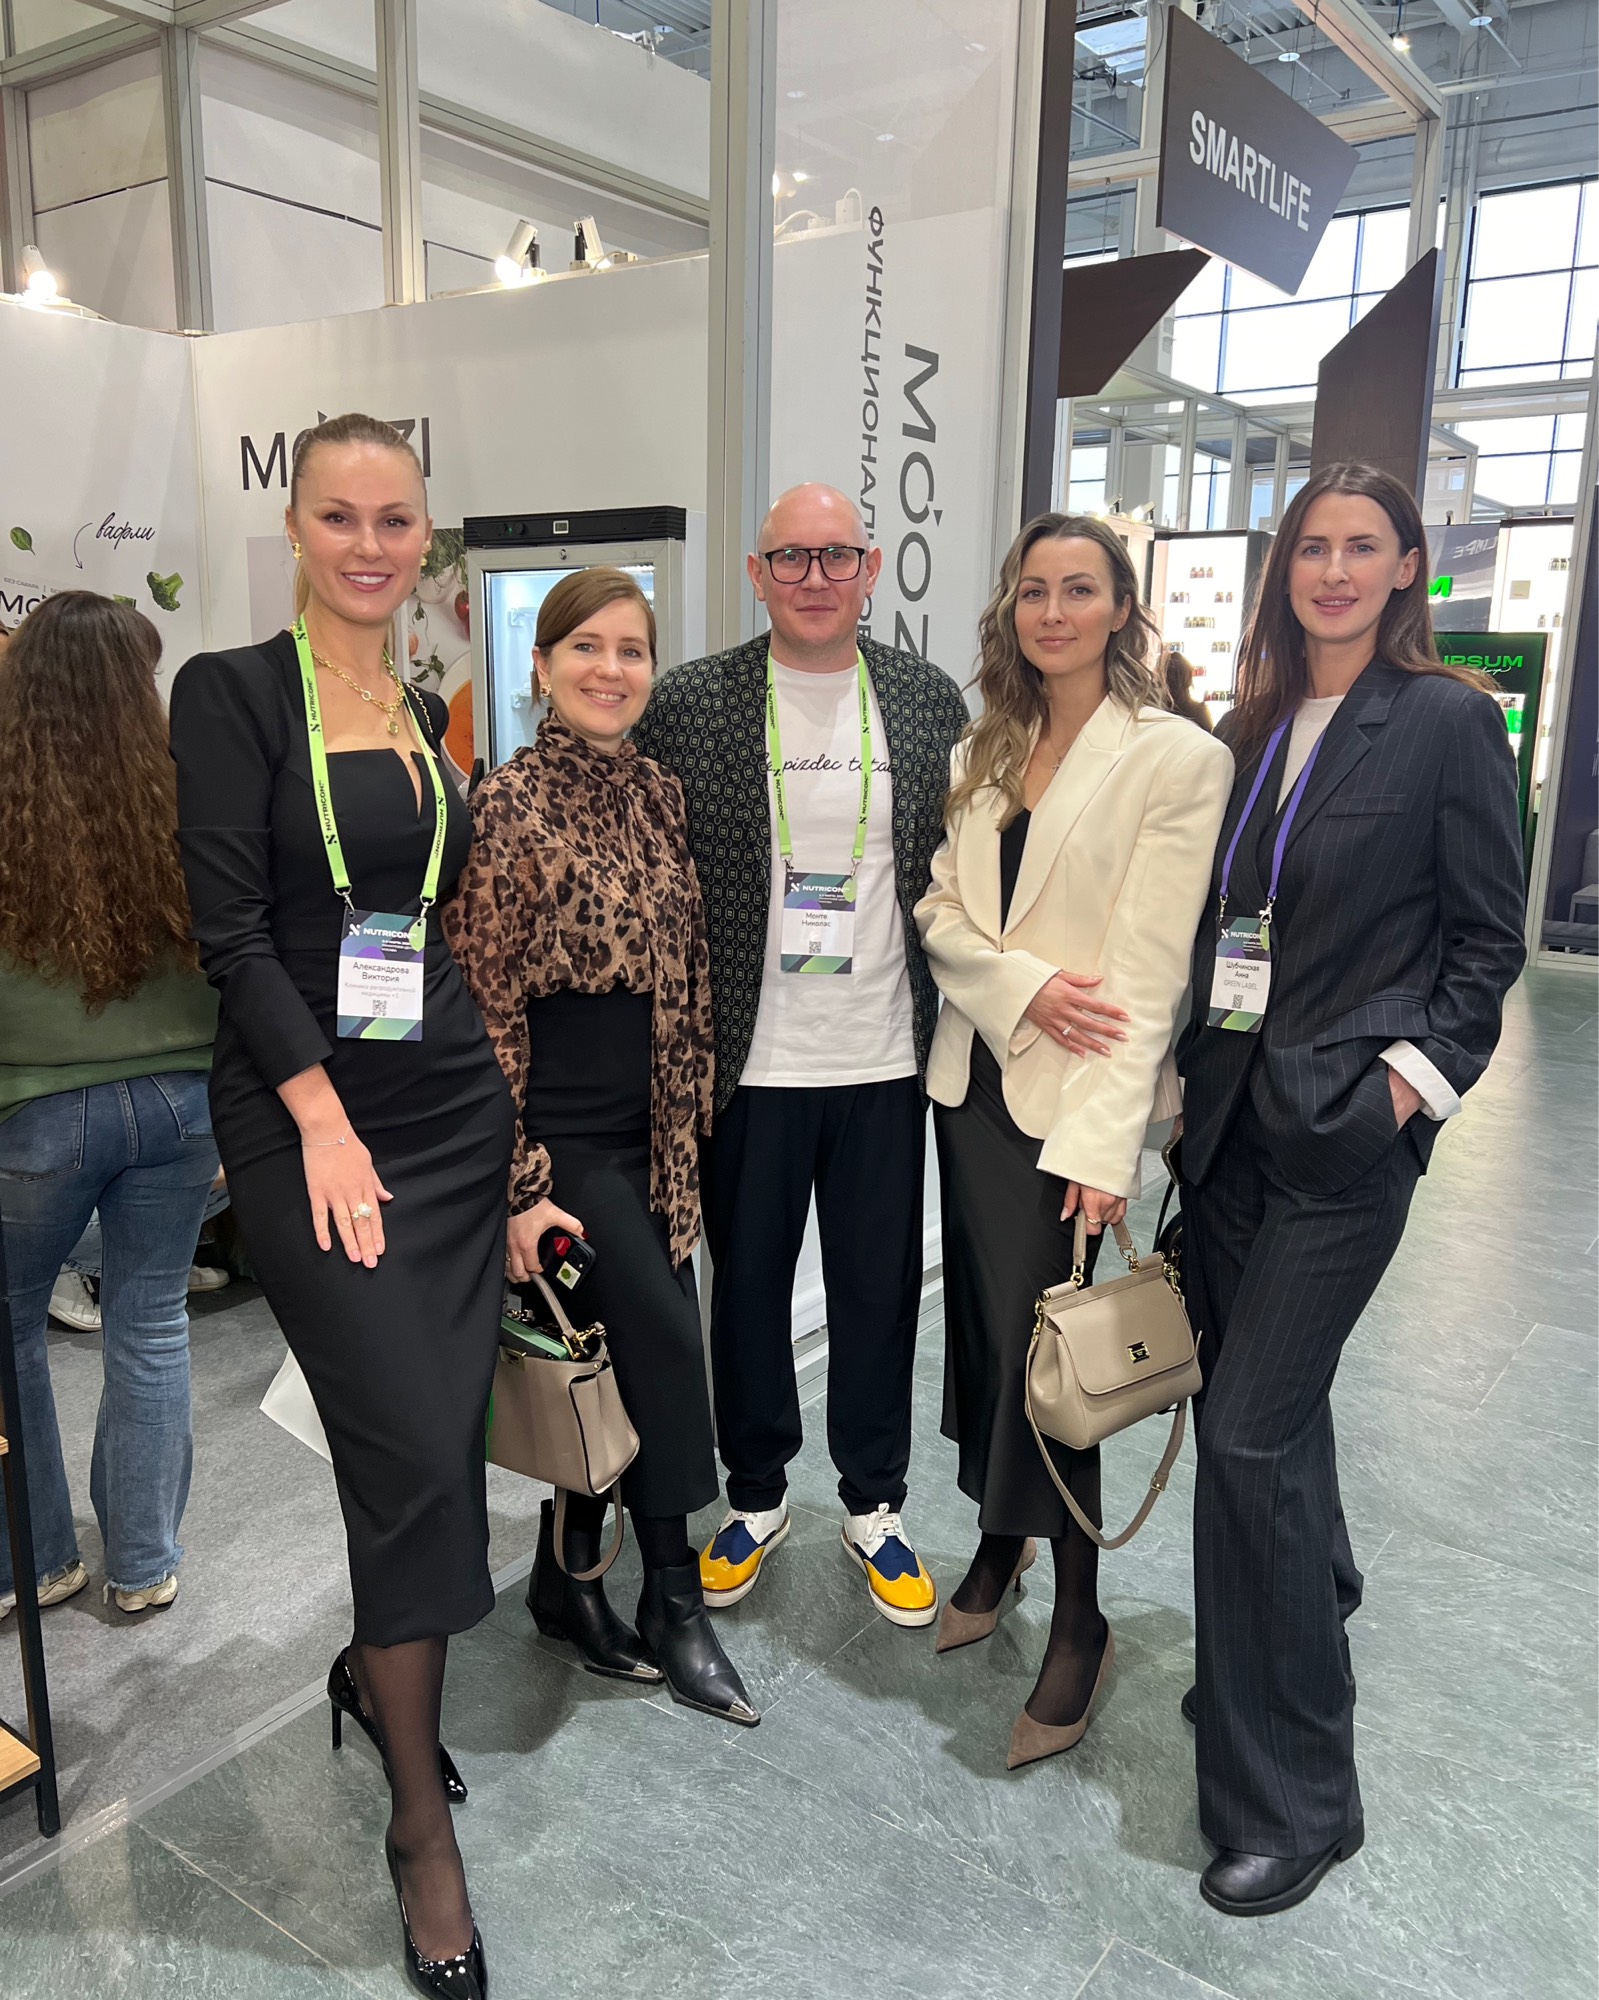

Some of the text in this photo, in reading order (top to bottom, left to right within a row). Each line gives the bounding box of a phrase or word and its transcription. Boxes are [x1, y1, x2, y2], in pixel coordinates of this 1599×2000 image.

[1189, 110, 1312, 232] SMARTLIFE
[894, 343, 943, 659] MOOZ
[96, 512, 155, 550] вафли
[1443, 655, 1523, 668] IPSUM
[783, 754, 843, 773] pizdec
[802, 885, 844, 893] NUTRICON
[363, 928, 410, 939] NUTRICON
[353, 962, 410, 975] Александрова
[362, 972, 400, 983] Виктория
[1224, 979, 1258, 991] GREEN LABEL
